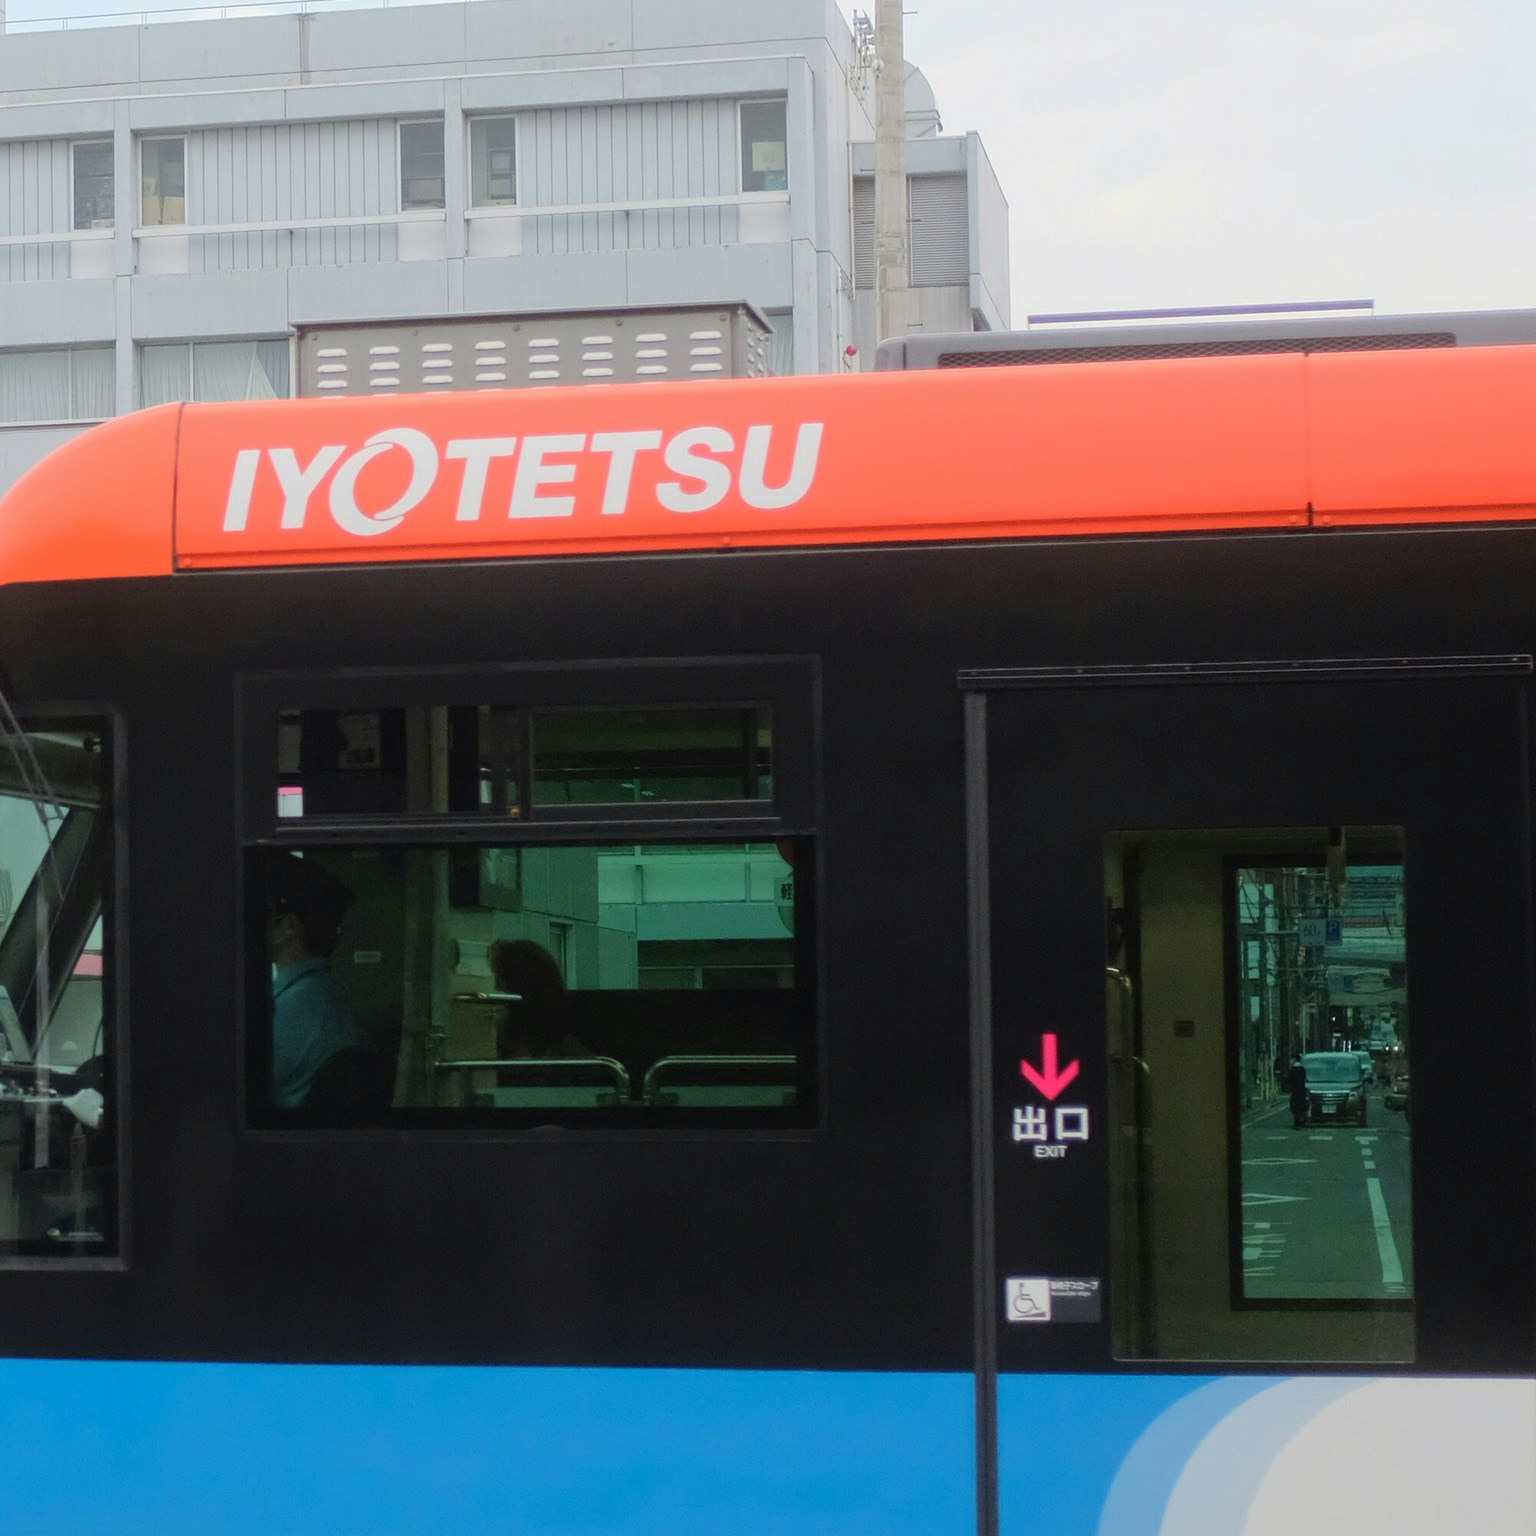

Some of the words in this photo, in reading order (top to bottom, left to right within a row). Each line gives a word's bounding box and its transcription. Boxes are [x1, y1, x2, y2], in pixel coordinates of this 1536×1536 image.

[222, 423, 824, 536] IYOTETSU
[1013, 1106, 1088, 1141] 出口
[1034, 1145, 1068, 1157] EXIT
